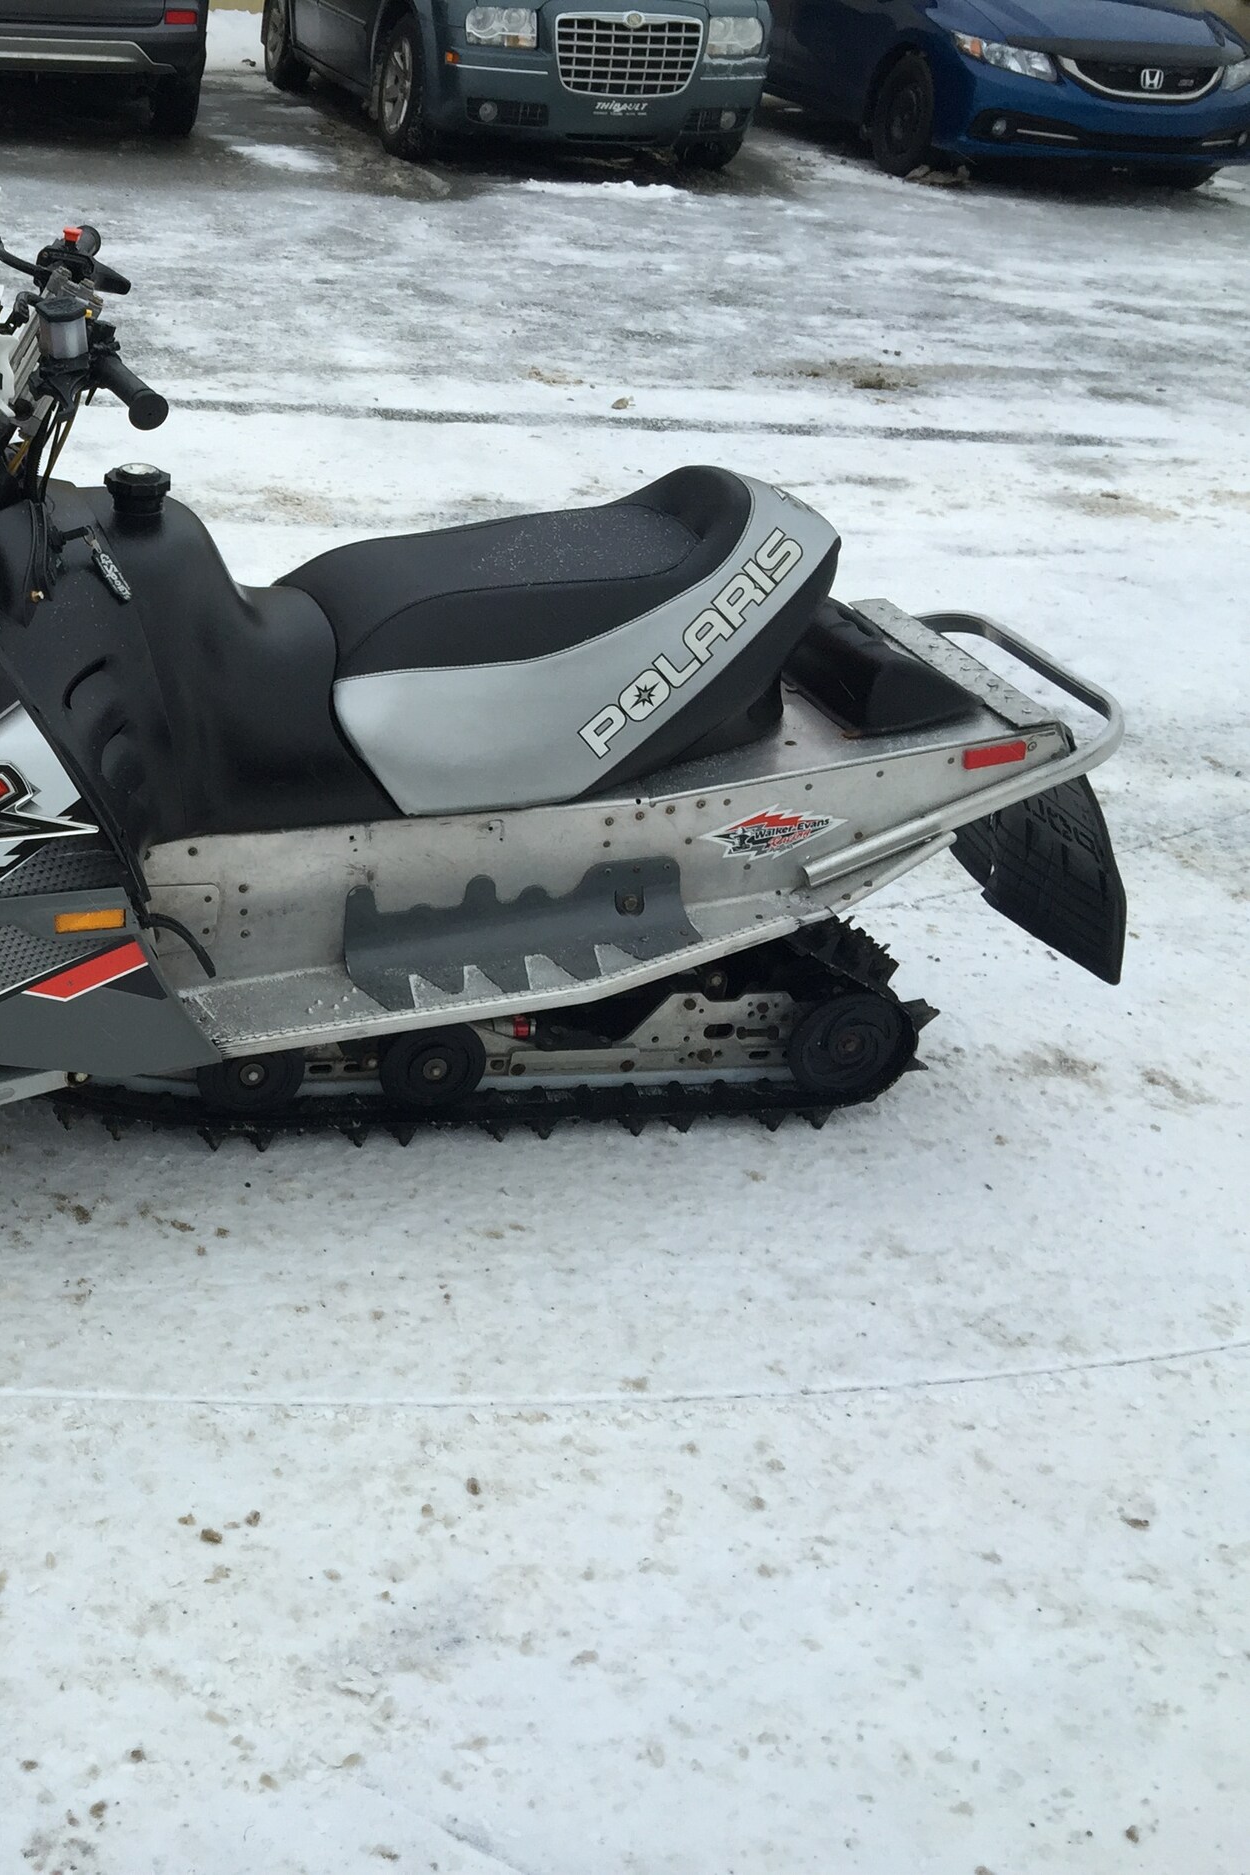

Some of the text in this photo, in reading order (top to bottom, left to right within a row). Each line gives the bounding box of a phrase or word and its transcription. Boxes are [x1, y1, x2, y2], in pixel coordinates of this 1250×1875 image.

[577, 527, 804, 759] POLARIS
[754, 818, 831, 839] Walker Evans
